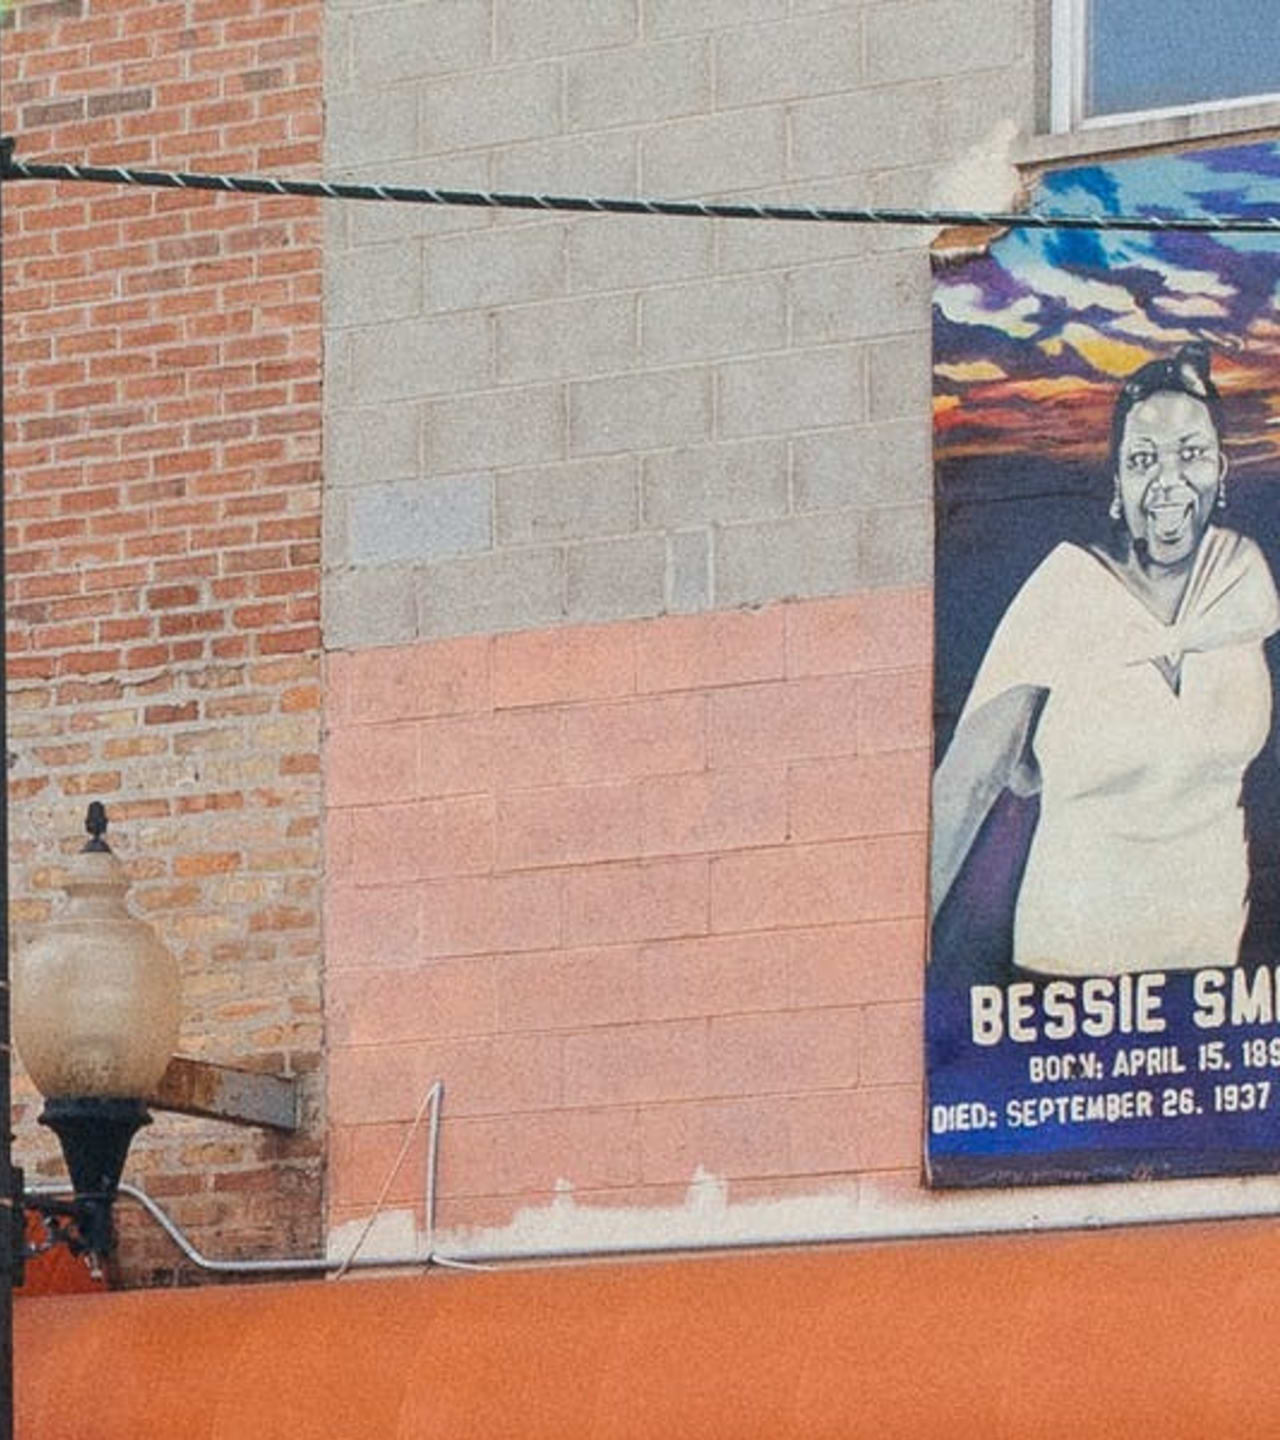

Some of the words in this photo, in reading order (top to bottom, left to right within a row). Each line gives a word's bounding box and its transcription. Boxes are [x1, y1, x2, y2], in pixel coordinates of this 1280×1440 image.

[970, 972, 1167, 1046] BESSIE
[1112, 1046, 1186, 1078] APRIL
[932, 1104, 998, 1134] DIED:
[1006, 1090, 1153, 1129] SEPTEMBER
[1214, 1081, 1271, 1113] 1937
